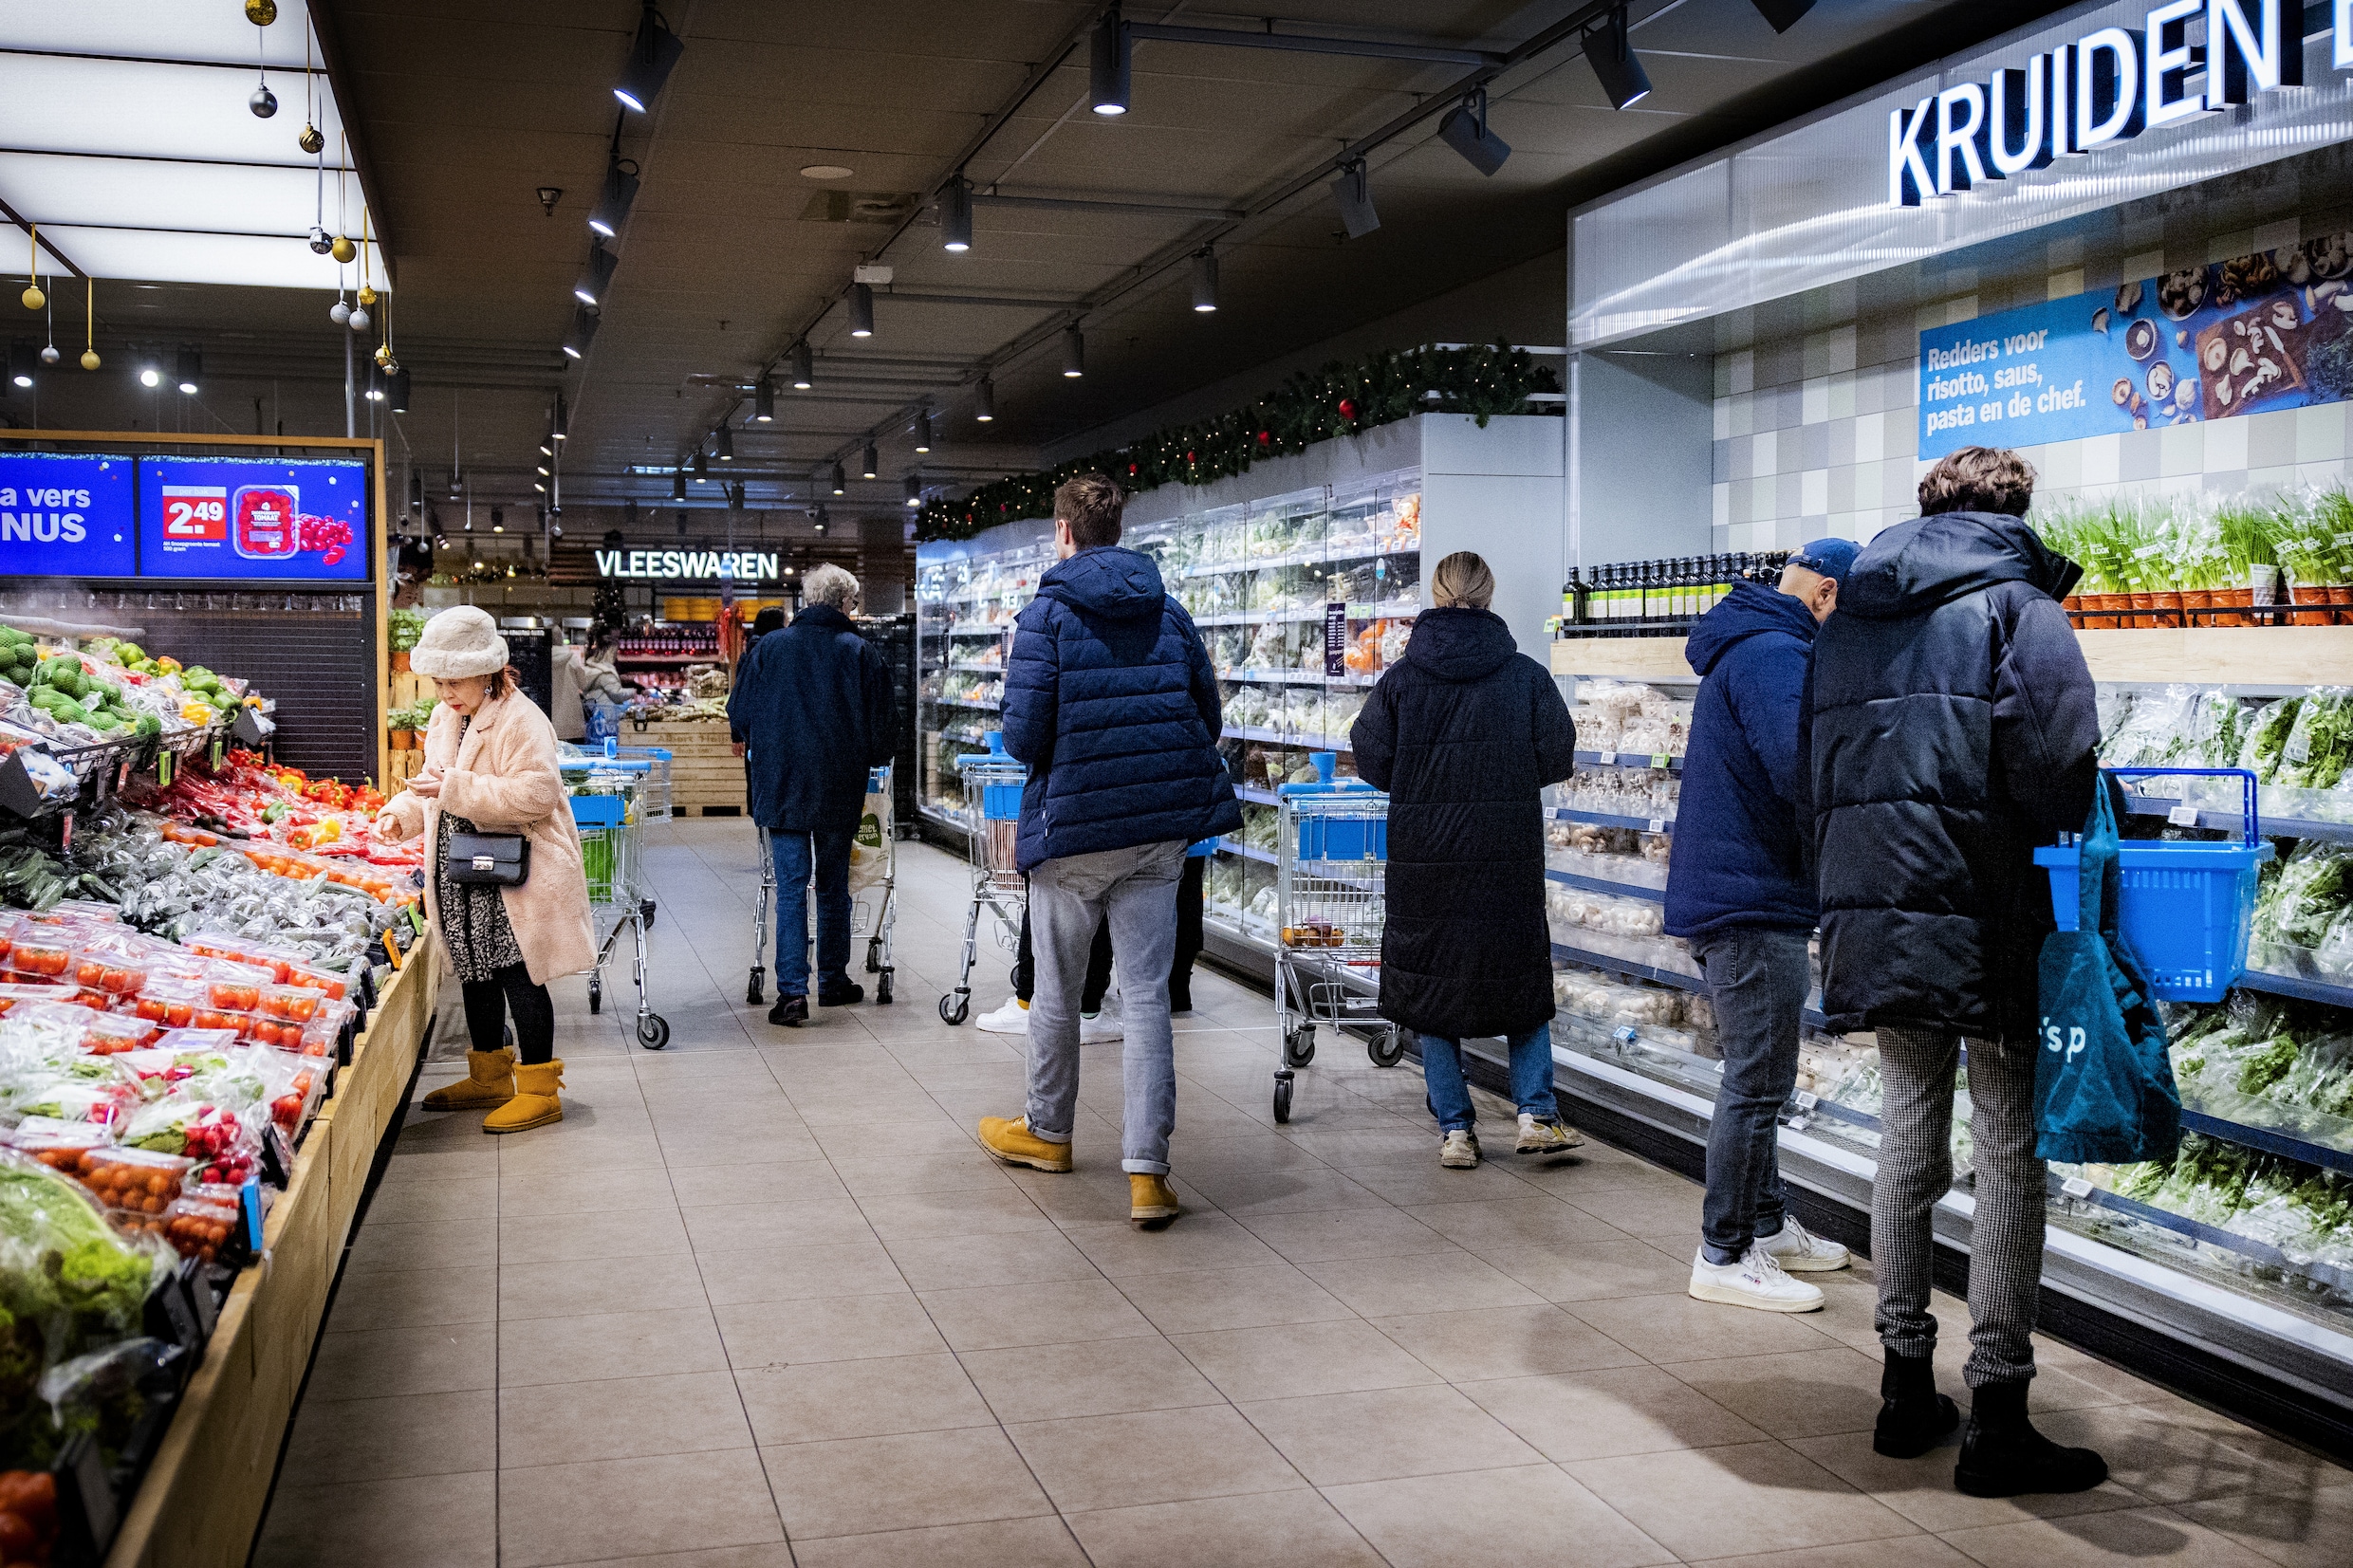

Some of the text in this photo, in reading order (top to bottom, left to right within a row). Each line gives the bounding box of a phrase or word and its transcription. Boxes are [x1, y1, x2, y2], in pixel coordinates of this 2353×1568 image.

[1890, 0, 2281, 209] KRUIDEN
[1928, 329, 2048, 372] Redders voor
[1927, 362, 2043, 402] risotto, saus,
[1927, 379, 2086, 437] pasta en de chef.
[26, 488, 91, 508] vers
[1, 512, 86, 543] NUS
[168, 501, 224, 534] 2.49
[595, 549, 779, 580] VLEESWAREN
